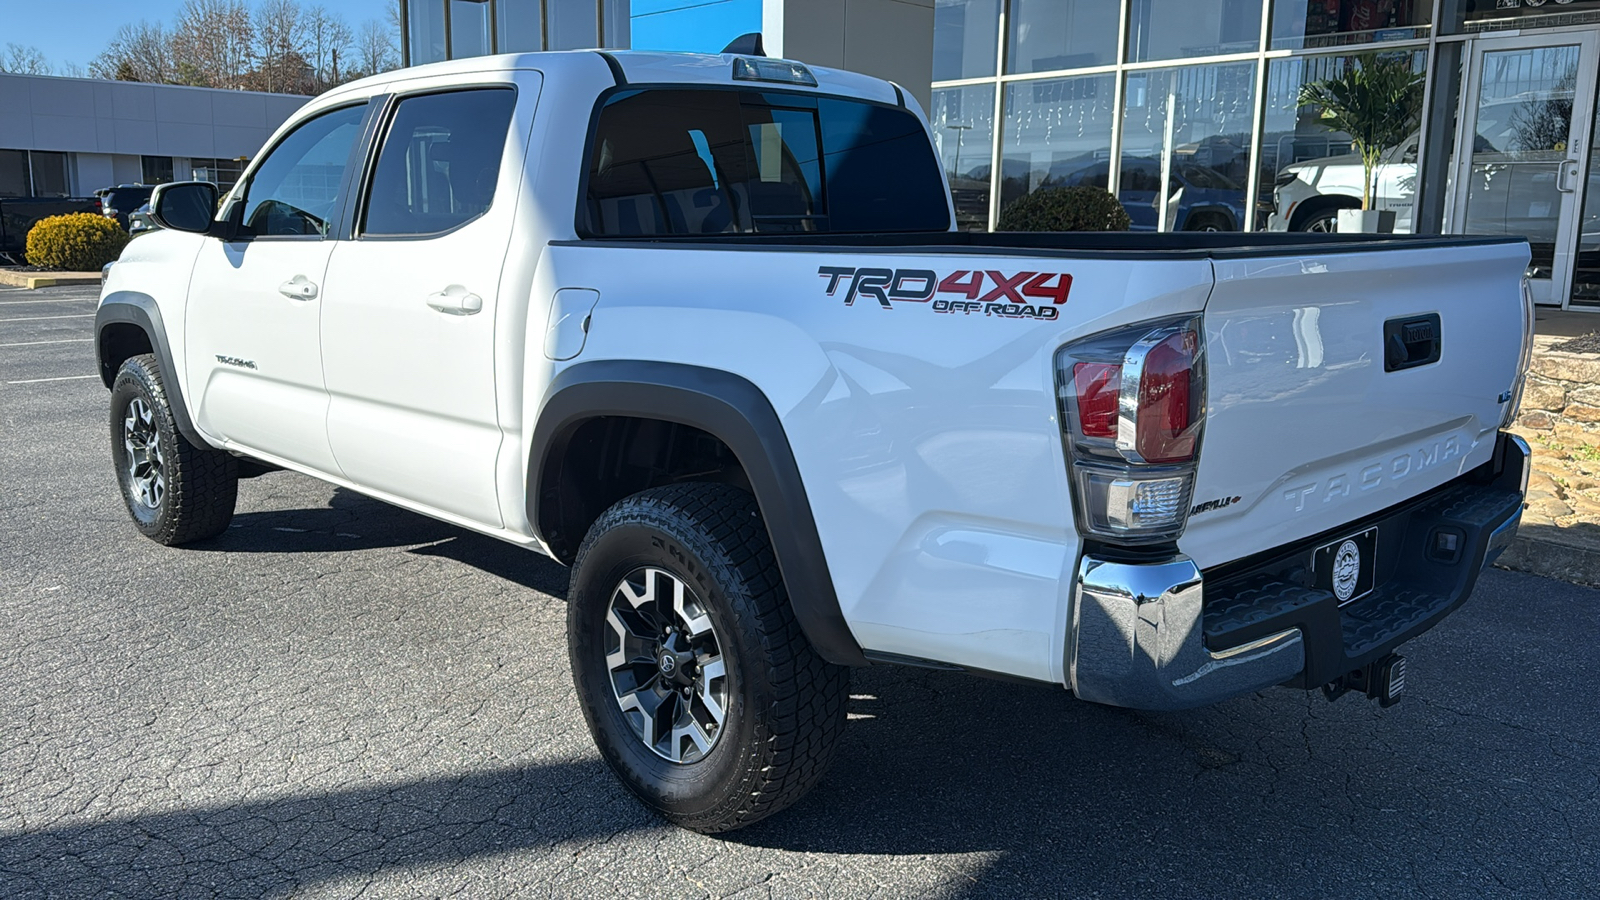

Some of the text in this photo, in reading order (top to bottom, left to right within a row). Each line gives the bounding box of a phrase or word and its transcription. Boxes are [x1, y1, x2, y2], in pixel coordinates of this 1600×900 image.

[818, 266, 1074, 309] TRD 4X4
[932, 300, 1060, 321] OFF ROAD
[1408, 326, 1435, 342] TOYOTA
[1284, 434, 1460, 513] TACOMA
